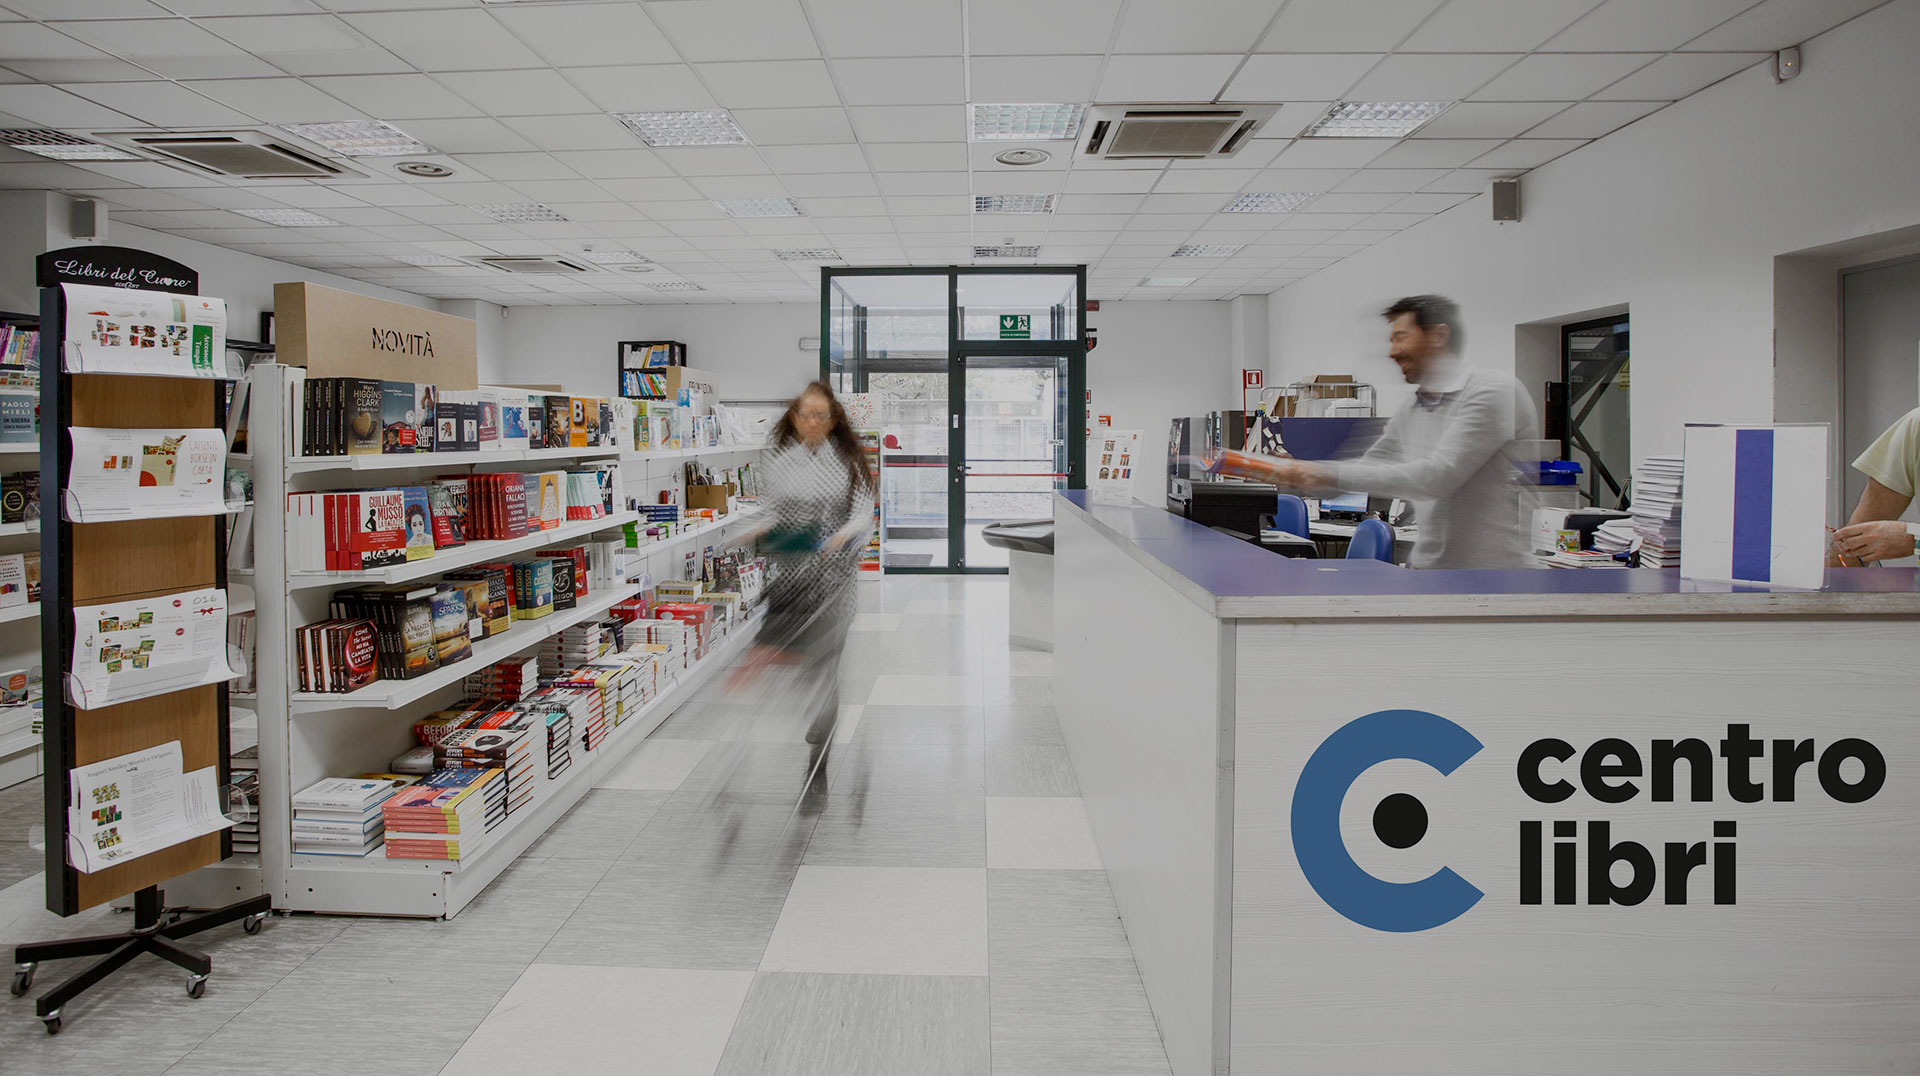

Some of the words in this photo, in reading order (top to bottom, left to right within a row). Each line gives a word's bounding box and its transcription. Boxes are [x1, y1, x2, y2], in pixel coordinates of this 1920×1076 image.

[54, 260, 109, 276] Libri
[110, 266, 137, 282] del
[371, 327, 435, 359] NOVITÀ
[353, 389, 382, 399] HIGGINS
[356, 398, 380, 407] CLARK
[416, 426, 434, 438] ANIELLE
[505, 485, 525, 493] ORIANA
[368, 494, 403, 509] GUILLAUME
[377, 505, 404, 521] MUSSO
[438, 602, 465, 615] SPARKS
[351, 645, 375, 658] CAMBIATO
[1517, 723, 1886, 803] centro
[1520, 820, 1737, 906] libri
